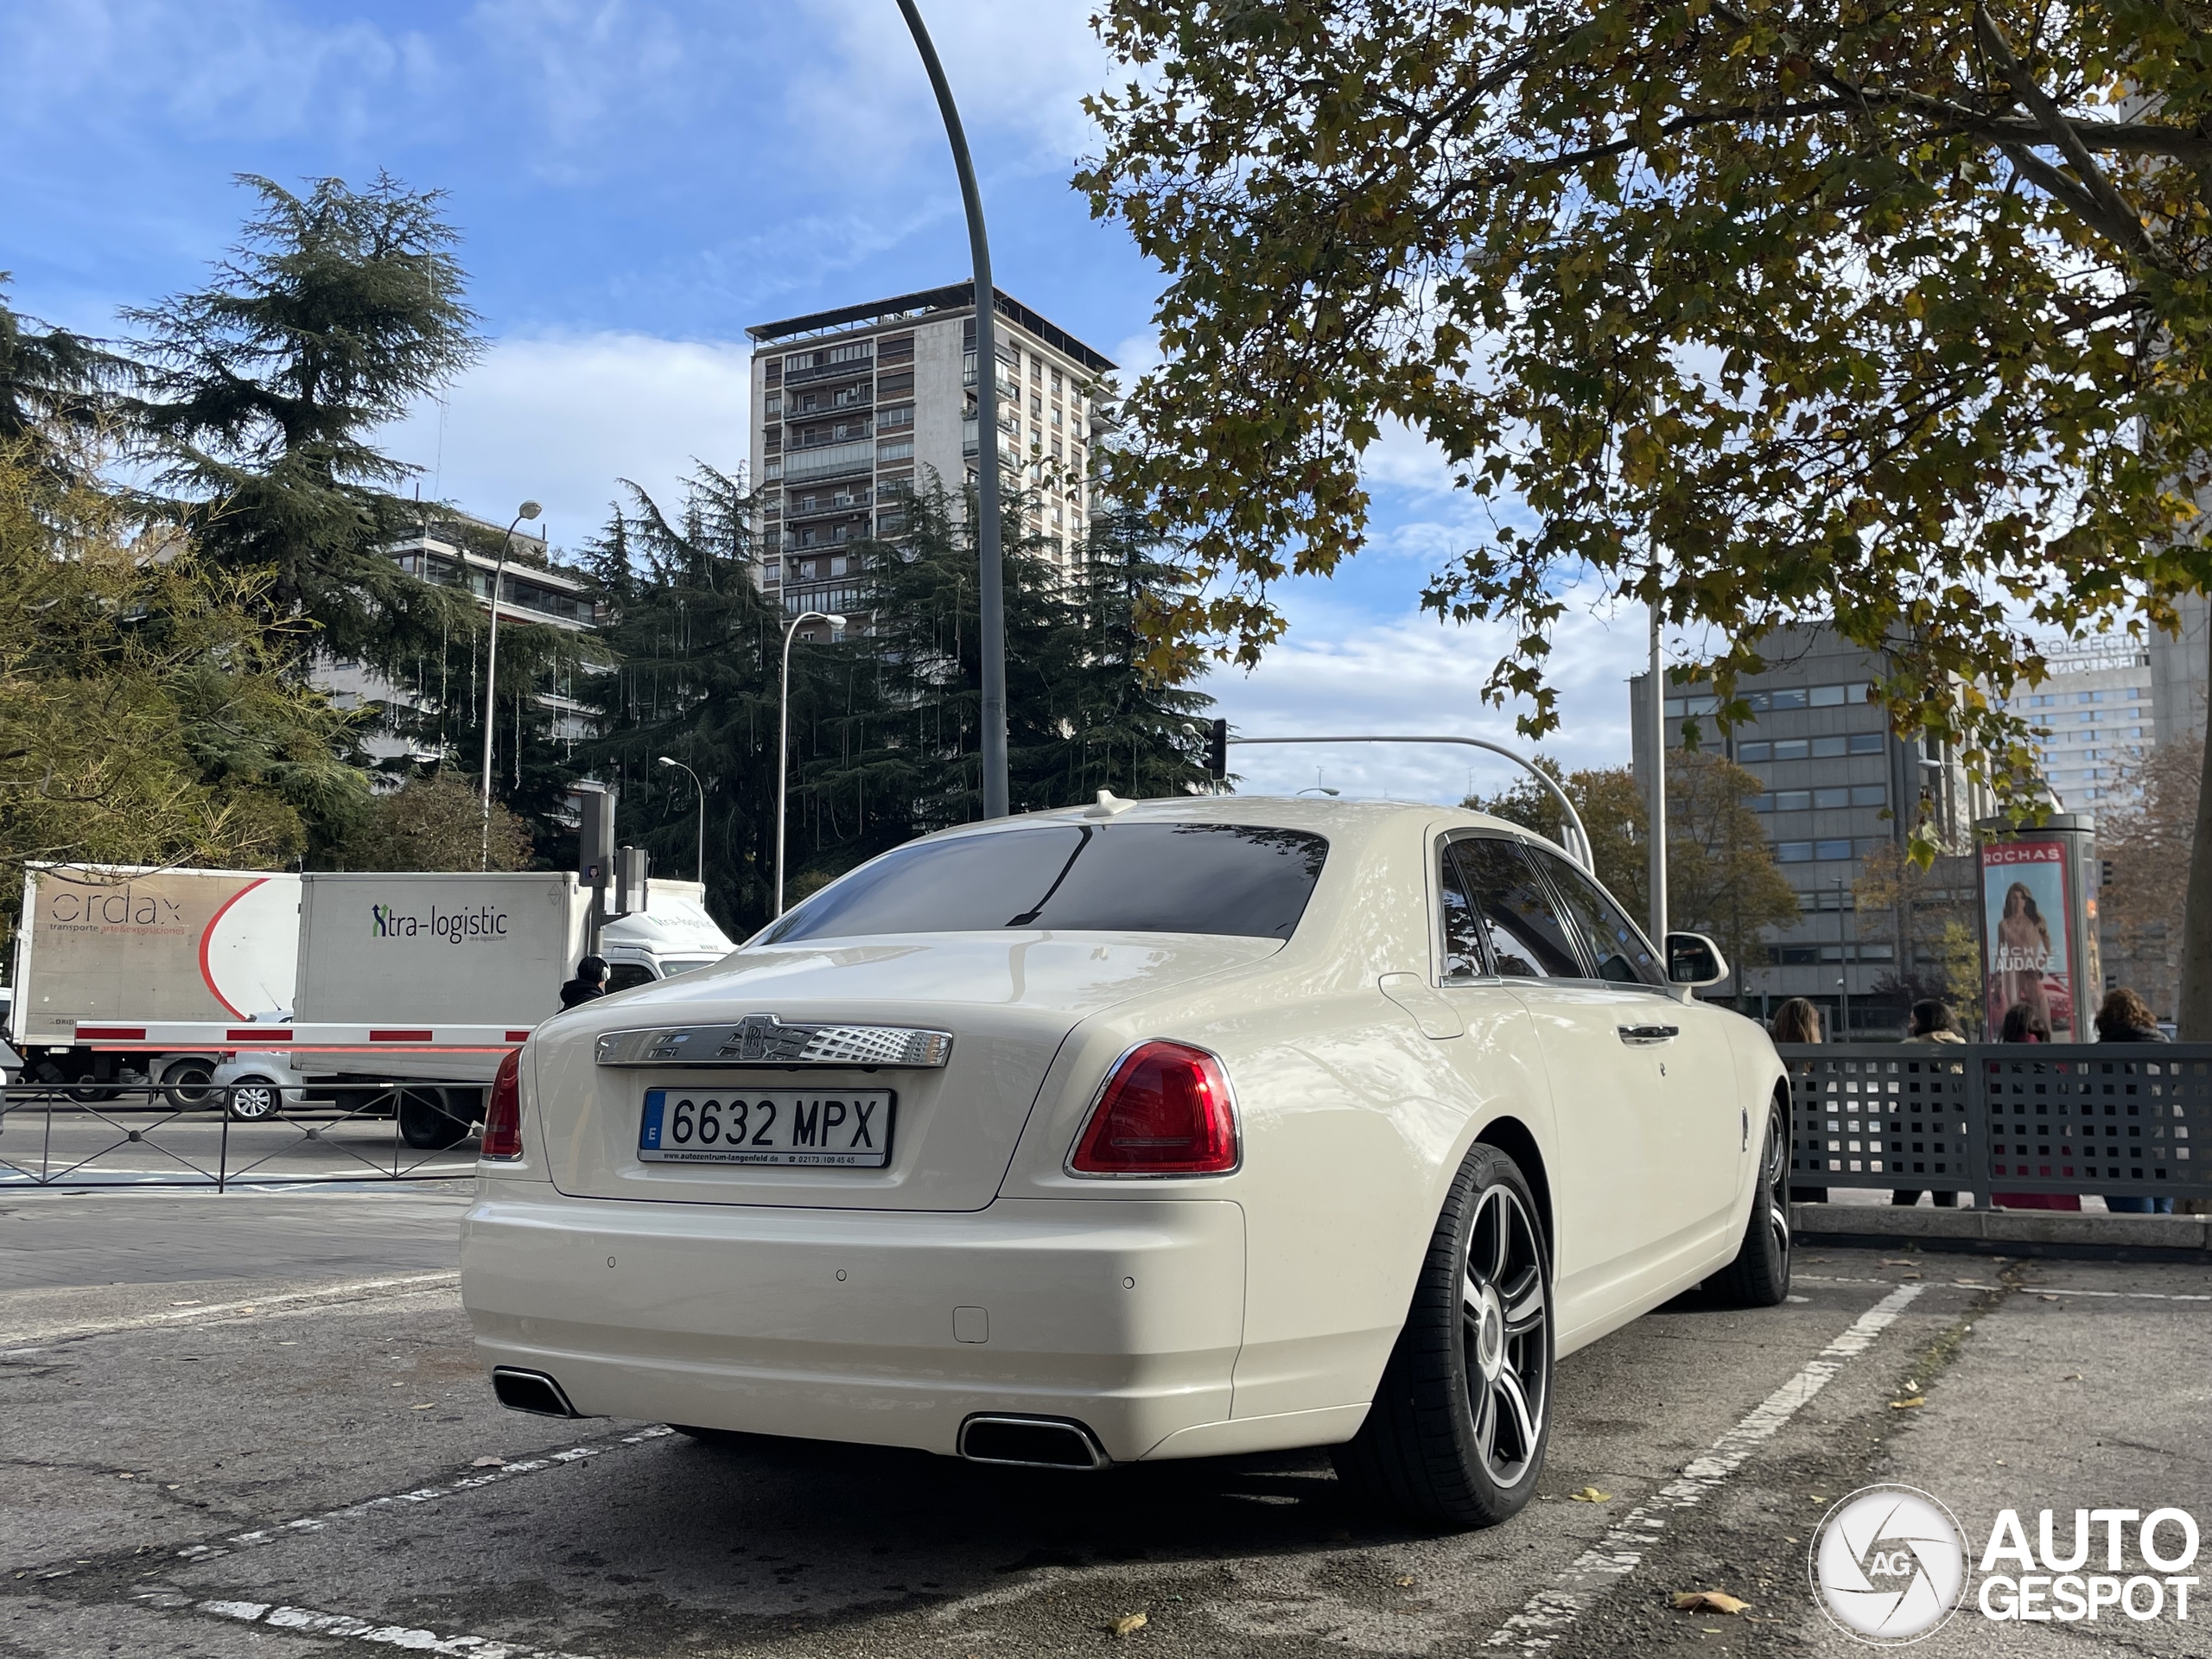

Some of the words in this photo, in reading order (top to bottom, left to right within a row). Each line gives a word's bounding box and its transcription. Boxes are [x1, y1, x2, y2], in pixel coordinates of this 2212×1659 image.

[2035, 632, 2150, 657] COLLECTI
[1983, 848, 2061, 864] ROCHAS
[50, 923, 99, 932] transporte
[101, 925, 185, 936] arte&exposiciones
[1991, 945, 2062, 957] OCHA
[1995, 955, 2056, 973] AUDACE
[671, 1098, 777, 1146] 6632
[791, 1100, 877, 1148] MPX
[648, 1127, 657, 1141] E
